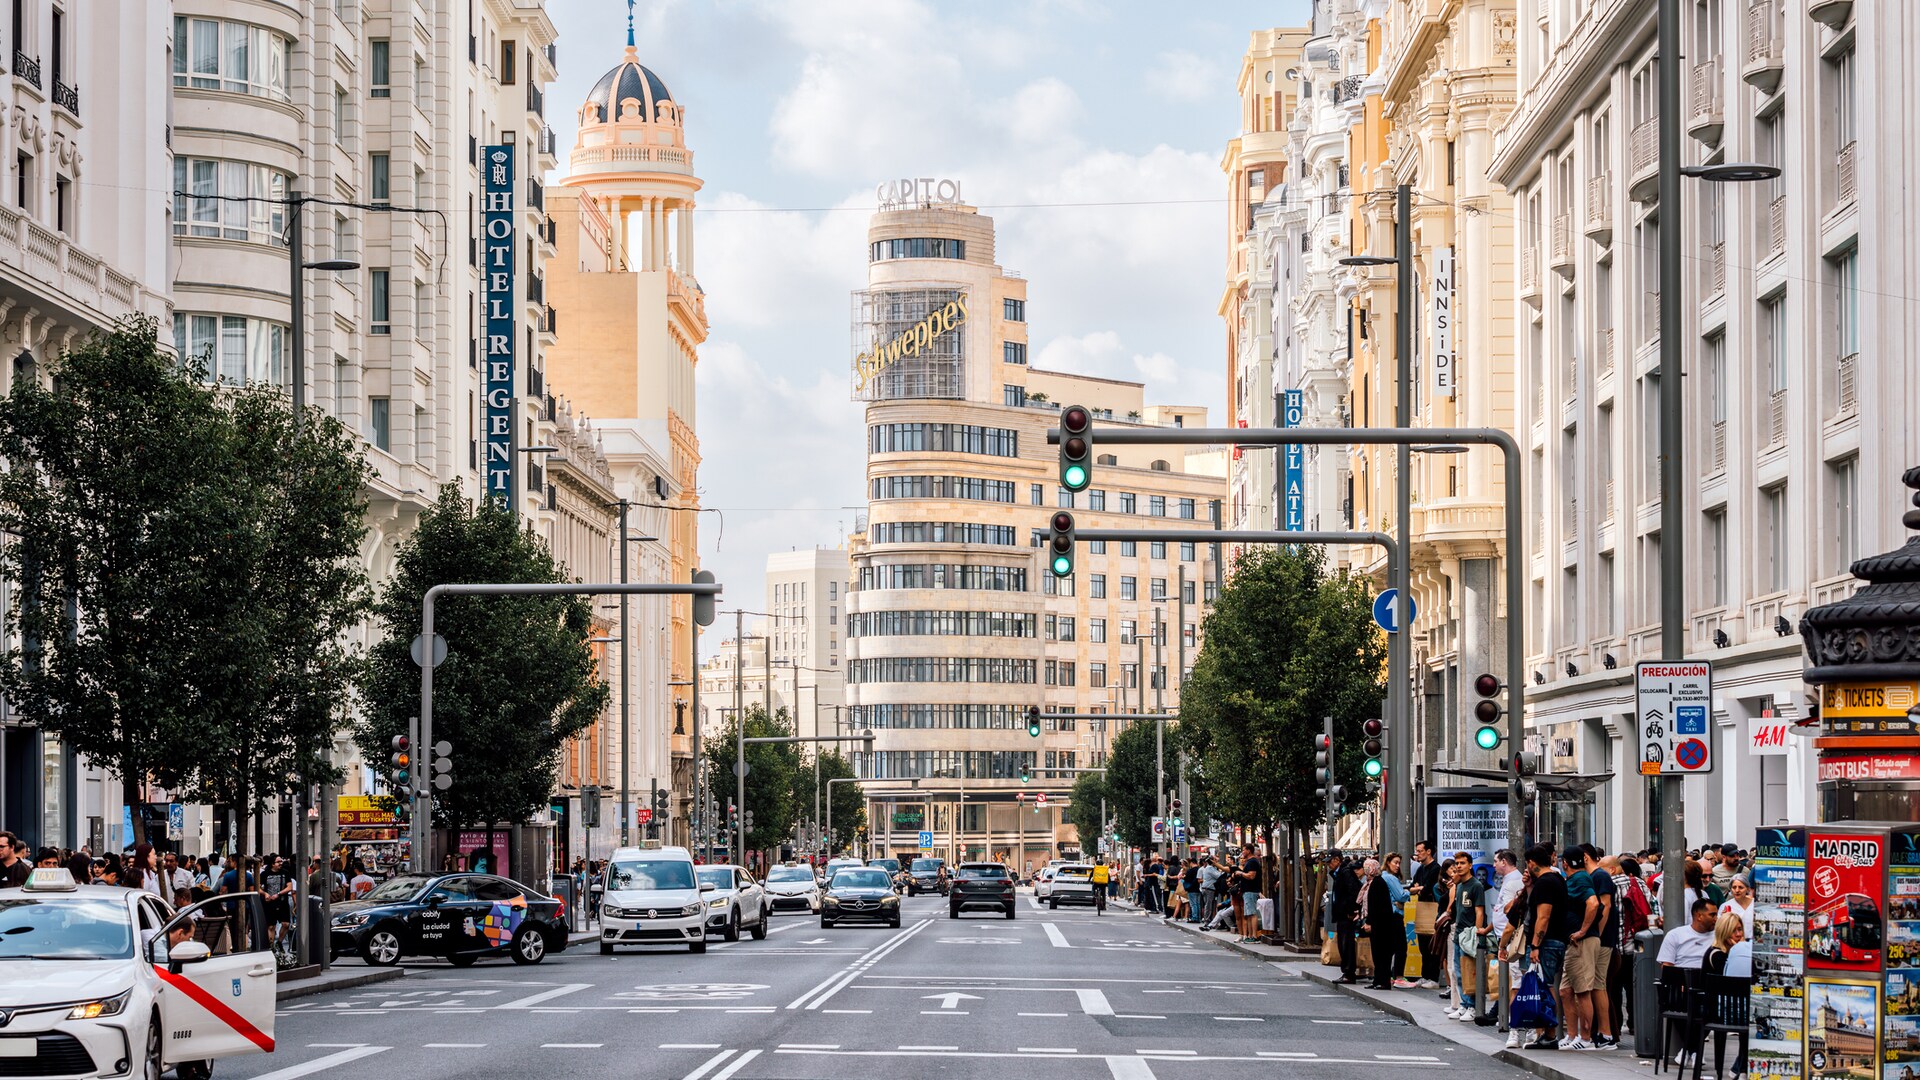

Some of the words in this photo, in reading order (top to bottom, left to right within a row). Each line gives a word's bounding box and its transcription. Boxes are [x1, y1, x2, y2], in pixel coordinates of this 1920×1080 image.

[876, 178, 965, 203] CAPITOL
[486, 191, 513, 320] HOTEL
[856, 292, 969, 392] Schweppes
[1287, 393, 1301, 470] HOEL
[1642, 665, 1707, 677] PRECAUCIÓN
[1844, 688, 1884, 708] TICKETS
[1753, 725, 1786, 747] H&M
[1847, 761, 1869, 778] BUS
[1442, 811, 1448, 819] SE
[1449, 811, 1464, 819] LLAMA
[1465, 811, 1482, 819] TIEMPO
[1484, 811, 1489, 819] DE
[1490, 811, 1505, 819] JUEGO
[1443, 821, 1461, 829] PORQUE
[1484, 821, 1495, 829] PARA
[1443, 831, 1472, 839] ESCUCHANDO
[1474, 831, 1478, 839] EL
[1480, 831, 1496, 839] MEJOR
[1443, 841, 1451, 849] ERA
[1452, 841, 1463, 849] MUY
[1814, 839, 1878, 859] MADRID
[35, 871, 57, 881] TAXI
[1767, 870, 1792, 879] PALACIO
[422, 910, 441, 919] cabify
[431, 922, 450, 930] ciudad
[430, 932, 443, 940] tuya
